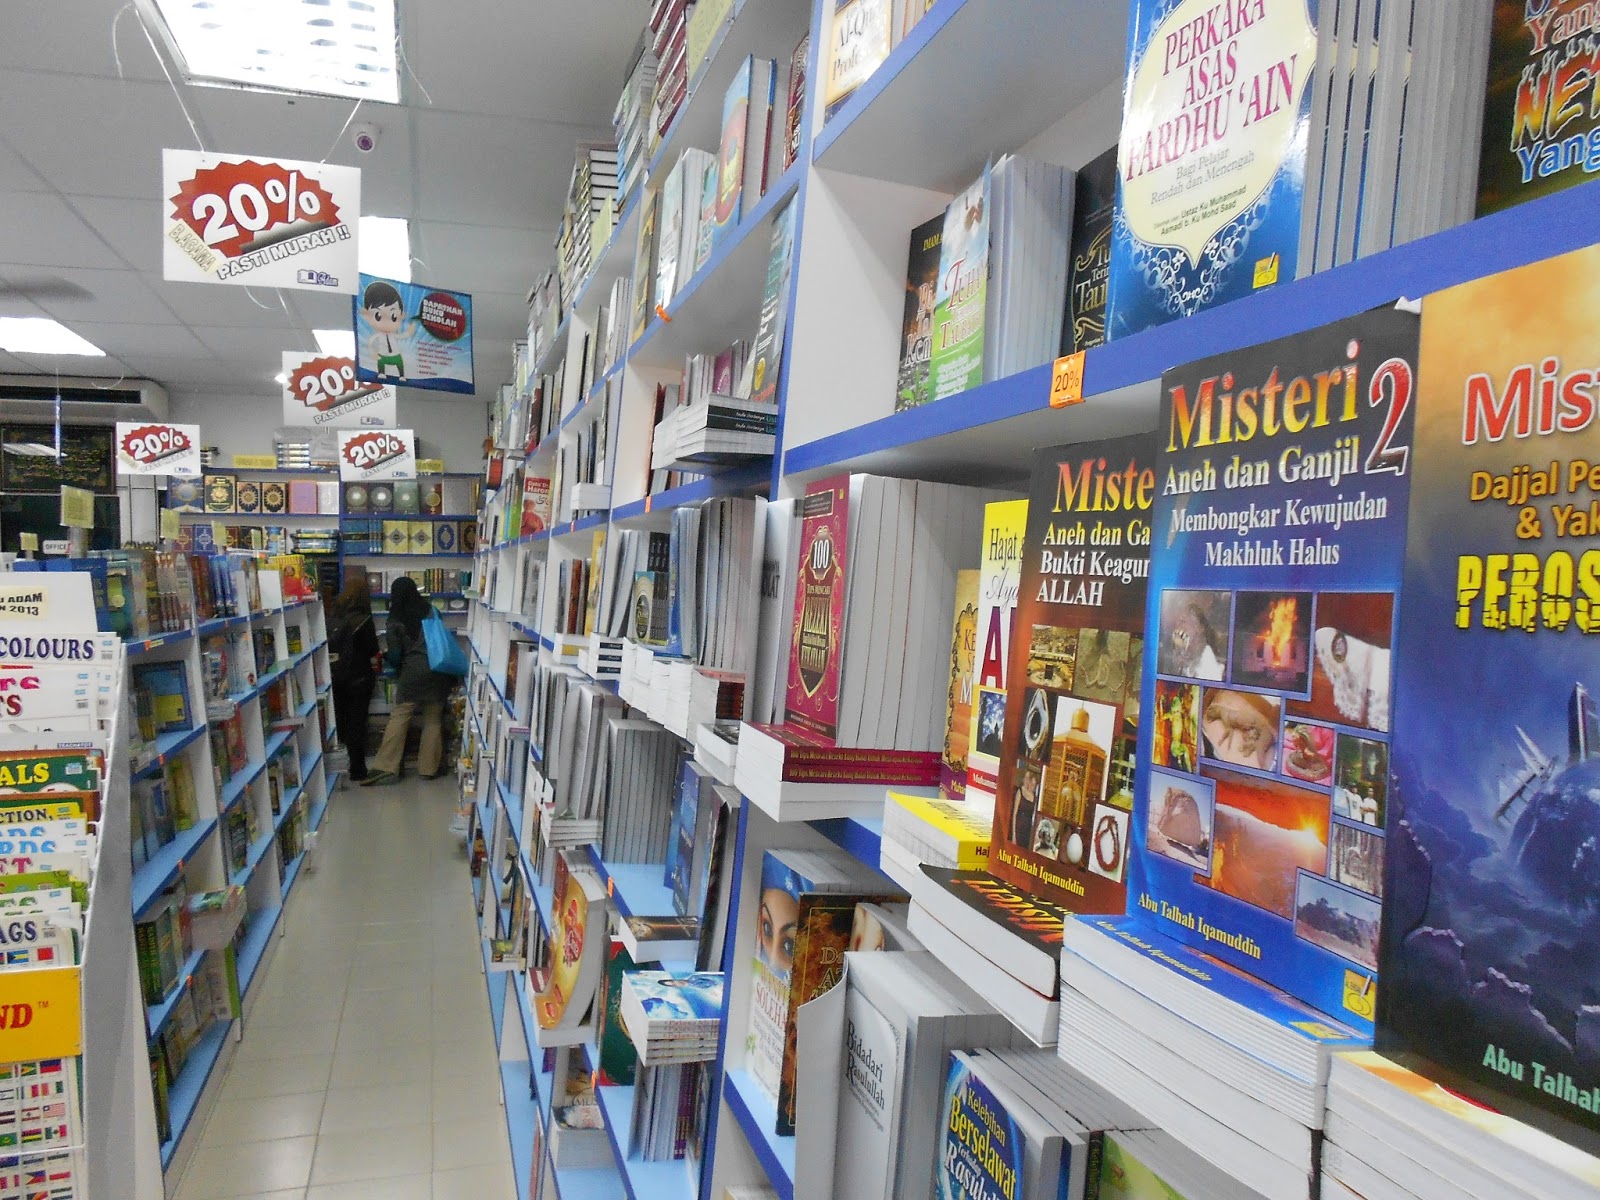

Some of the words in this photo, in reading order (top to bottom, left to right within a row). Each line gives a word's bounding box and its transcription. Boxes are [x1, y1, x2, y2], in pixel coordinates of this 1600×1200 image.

[1162, 0, 1267, 77] PERKARA
[1181, 40, 1239, 110] ASAS
[1125, 88, 1233, 183] FARDHU
[1150, 184, 1184, 205] Rendah
[1186, 175, 1203, 190] dan
[1204, 150, 1255, 183] Menengah
[1176, 163, 1196, 180] Bagi
[1198, 148, 1230, 170] Pelajar
[191, 171, 321, 246] 20%
[1201, 205, 1219, 220] Mohd
[217, 250, 270, 280] PASTI
[272, 229, 336, 261] MURAH
[421, 312, 457, 328] SEKOLAH
[1054, 369, 1080, 393] 20%
[1165, 337, 1361, 453] Misteri
[129, 428, 184, 460] 20%
[350, 434, 399, 468] 20%
[1161, 457, 1217, 497] Aneh
[1223, 454, 1271, 490] dan
[1278, 434, 1361, 488] Ganjil
[1051, 456, 1155, 514] Miste
[1470, 459, 1561, 506] Dajjal
[1042, 519, 1087, 546] Aneh
[1089, 521, 1122, 546] dan
[1170, 503, 1281, 537] Membongkar
[1284, 491, 1389, 531] Kewujudan
[1515, 506, 1543, 540] &
[45, 543, 67, 551] OFFICE
[812, 539, 830, 570] 100
[989, 527, 1018, 571] Hajat
[1039, 550, 1087, 576] Bukti
[1203, 538, 1285, 567] Makhluk
[1287, 537, 1340, 566] Halus
[7, 592, 43, 603] ADAM
[9, 605, 39, 616] 2013
[1036, 578, 1106, 607] ALLAH
[996, 849, 1012, 866] Abu
[1012, 856, 1038, 878] Talhah
[1038, 866, 1086, 897] Iqamuddin
[1137, 891, 1159, 913] Abu
[1160, 900, 1196, 932] Talhah
[1197, 916, 1262, 961] Iqamuddin
[846, 1019, 883, 1083] Bidadari
[1481, 1043, 1525, 1082] Abu
[846, 1051, 885, 1111] Rasulullah
[967, 1087, 1006, 1147] Kelebihan
[949, 1094, 1017, 1200] Berselawat
